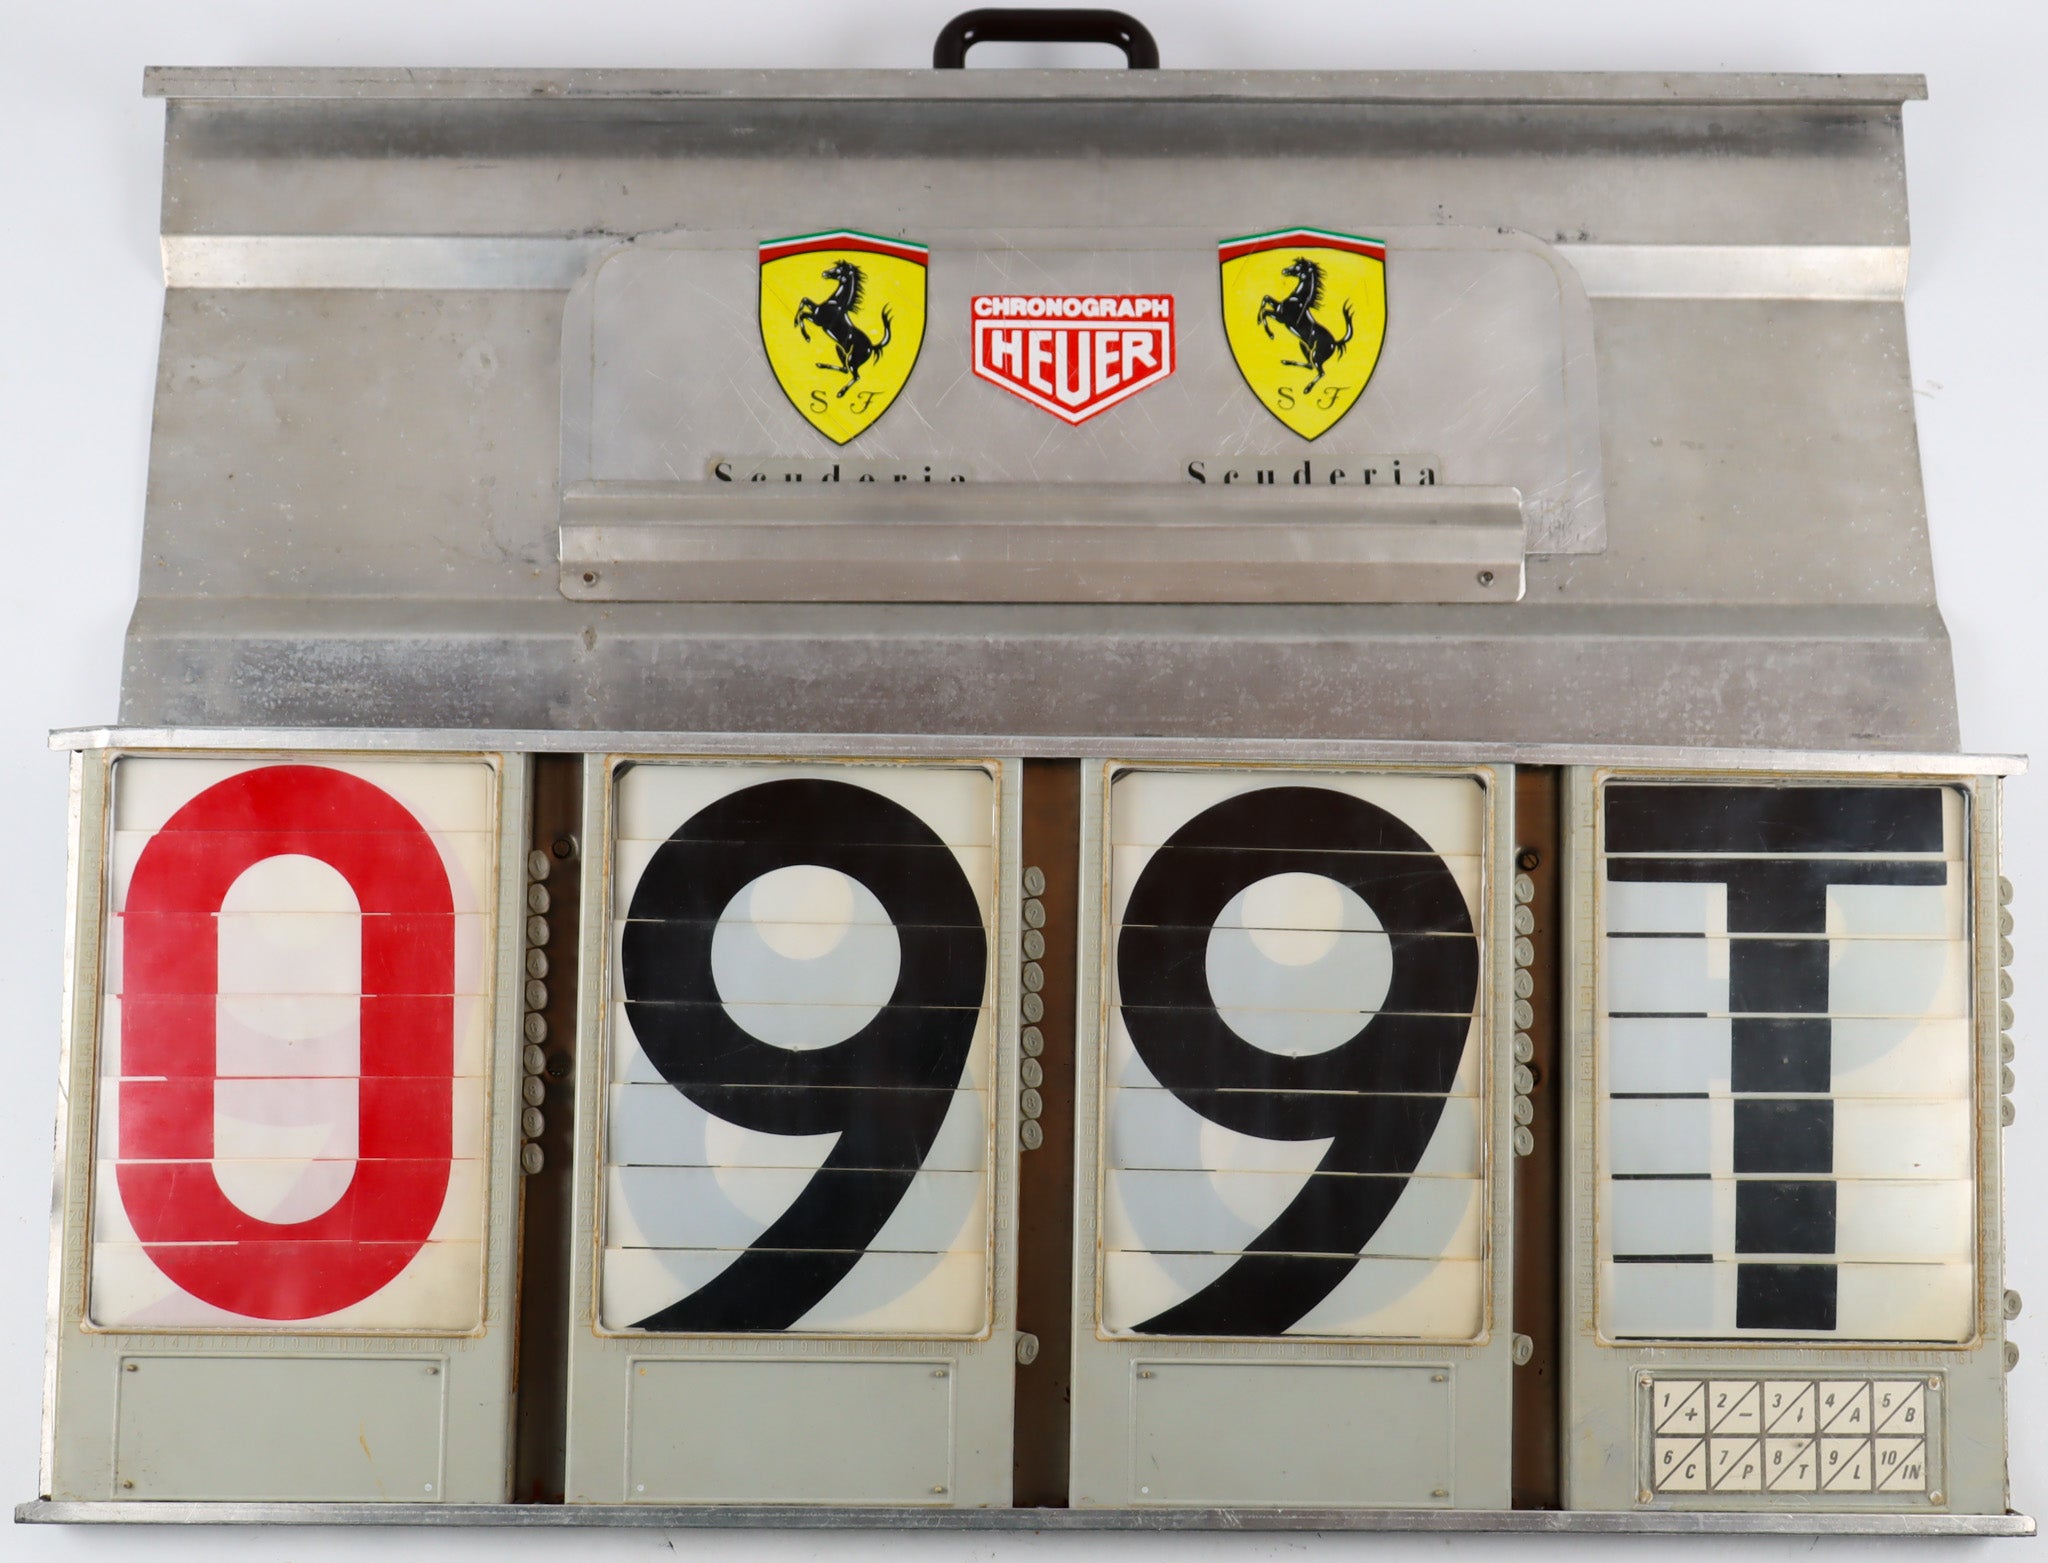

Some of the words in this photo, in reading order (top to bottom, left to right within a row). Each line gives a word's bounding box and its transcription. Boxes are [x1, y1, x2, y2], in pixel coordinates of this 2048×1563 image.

[974, 296, 1169, 318] CHRONOGRAPH
[991, 329, 1157, 407] HEUER
[809, 389, 828, 414] S
[1277, 386, 1295, 411] S
[115, 764, 456, 1322] 0
[622, 778, 987, 1331] 9
[1117, 785, 1480, 1333] 9
[1604, 785, 1947, 1331] T
[1663, 1392, 1671, 1408] 1
[1716, 1393, 1728, 1409] 2
[1772, 1393, 1782, 1408] 3
[1825, 1393, 1835, 1408] 4
[1849, 1407, 1860, 1422] A
[1882, 1393, 1892, 1408] 5
[1904, 1407, 1916, 1422] B
[1663, 1450, 1674, 1465] 6
[1685, 1464, 1696, 1479] C
[1718, 1450, 1729, 1465] 7
[1742, 1464, 1754, 1479] P
[1773, 1450, 1782, 1465] 8
[1799, 1464, 1809, 1479] T
[1828, 1450, 1839, 1465] 9
[1852, 1464, 1861, 1480] L
[1881, 1450, 1897, 1465] 10
[1902, 1464, 1921, 1480] IN
